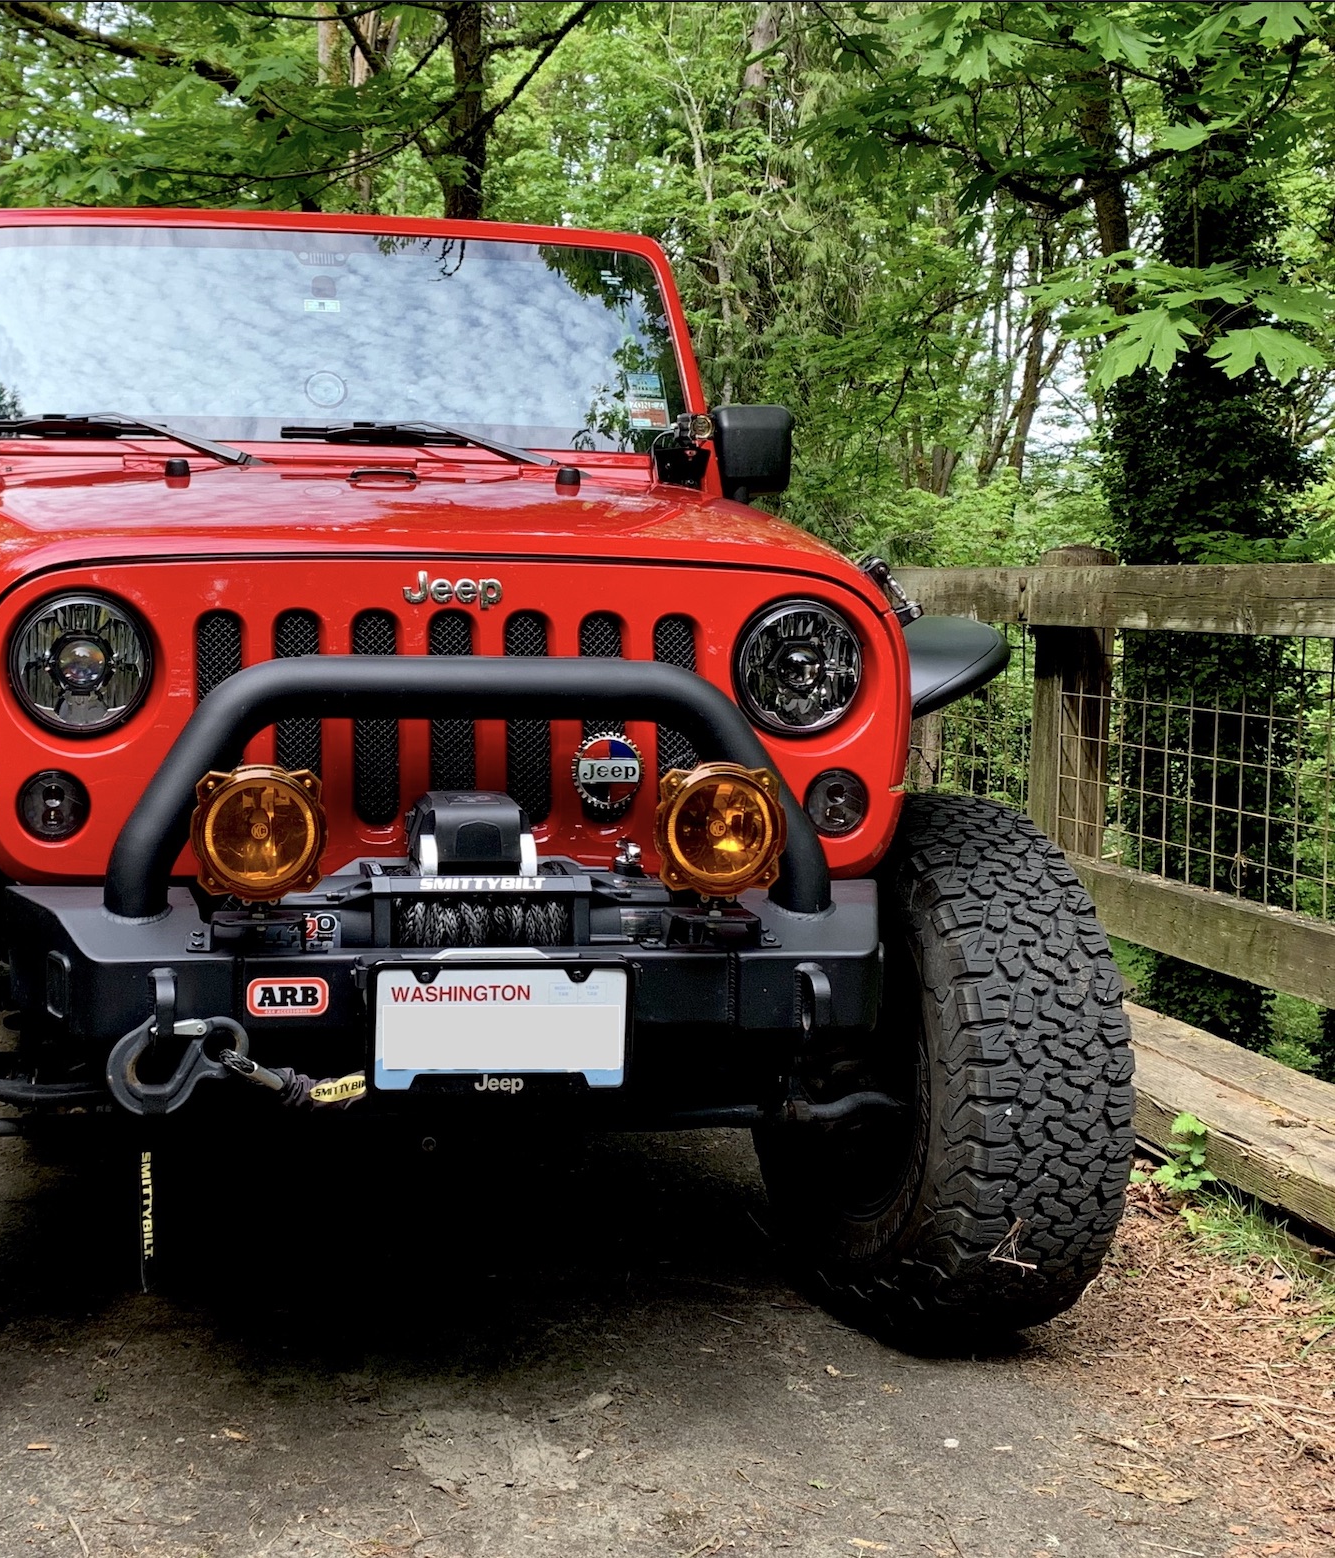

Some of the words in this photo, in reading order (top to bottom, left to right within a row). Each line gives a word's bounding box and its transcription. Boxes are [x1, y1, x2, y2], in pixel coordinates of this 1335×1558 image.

[402, 570, 502, 610] Jeep
[582, 762, 636, 780] Jeep
[420, 877, 546, 890] SMITTYBILT
[257, 986, 319, 1007] ARB
[391, 984, 531, 1002] WASHINGTON
[474, 1074, 524, 1094] Jeep
